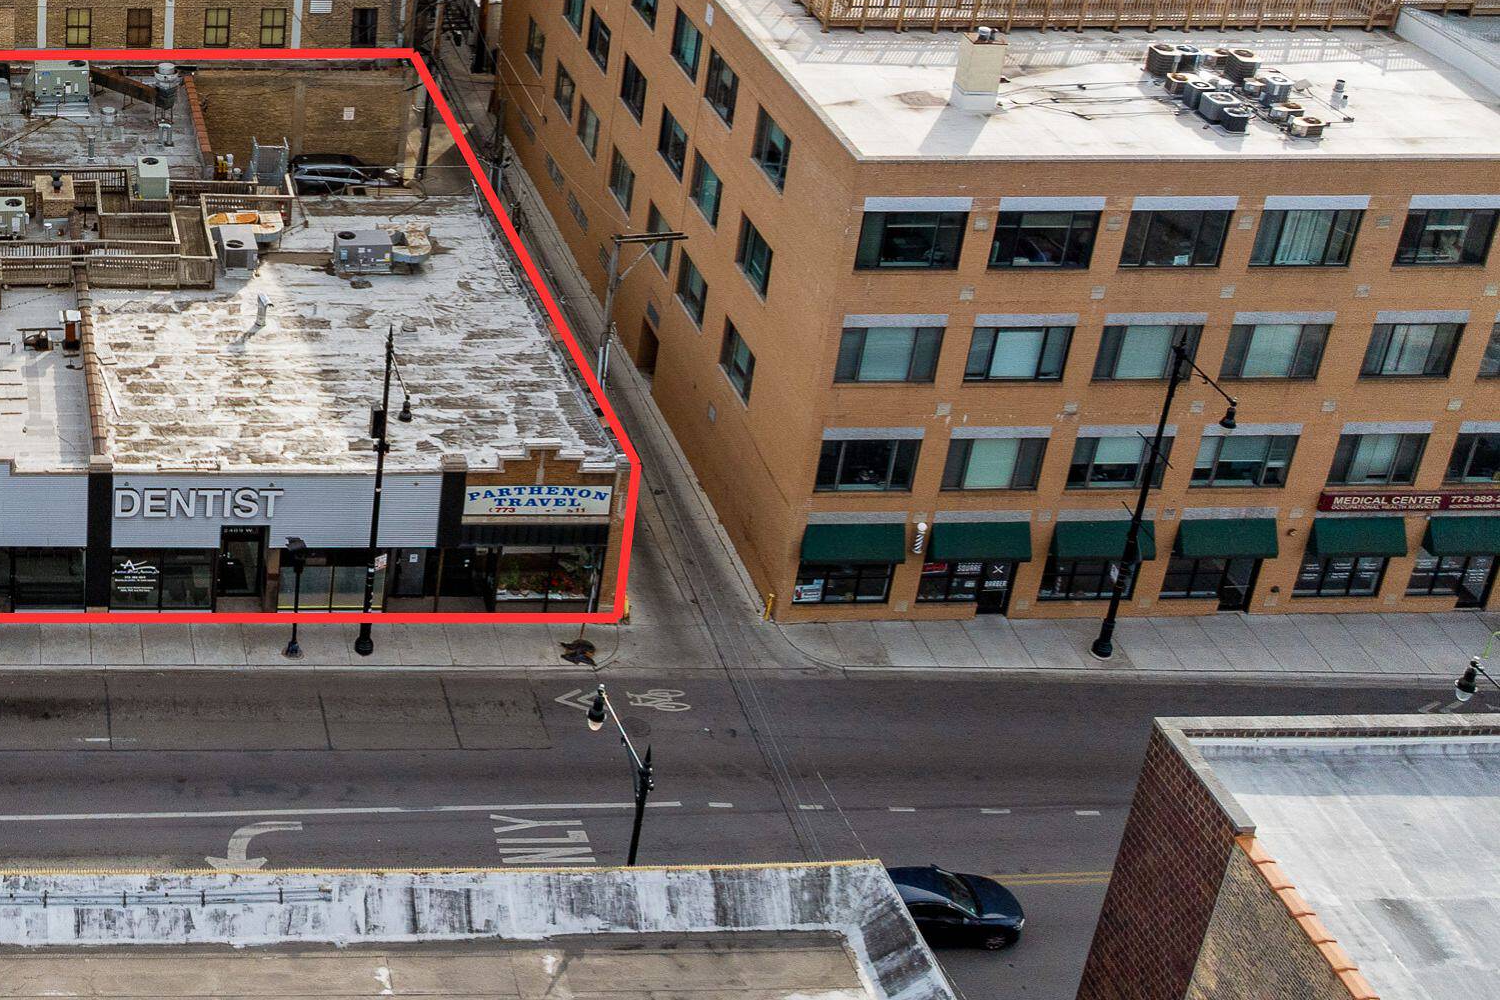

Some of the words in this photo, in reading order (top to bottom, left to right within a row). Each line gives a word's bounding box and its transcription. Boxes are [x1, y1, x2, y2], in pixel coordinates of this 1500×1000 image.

[467, 486, 609, 501] PARTHENON
[1333, 496, 1388, 505] MEDICAL
[1391, 496, 1442, 504] CENTER
[114, 487, 285, 518] DENTIST
[494, 498, 582, 507] TRAVEL
[490, 813, 596, 863] NLY
